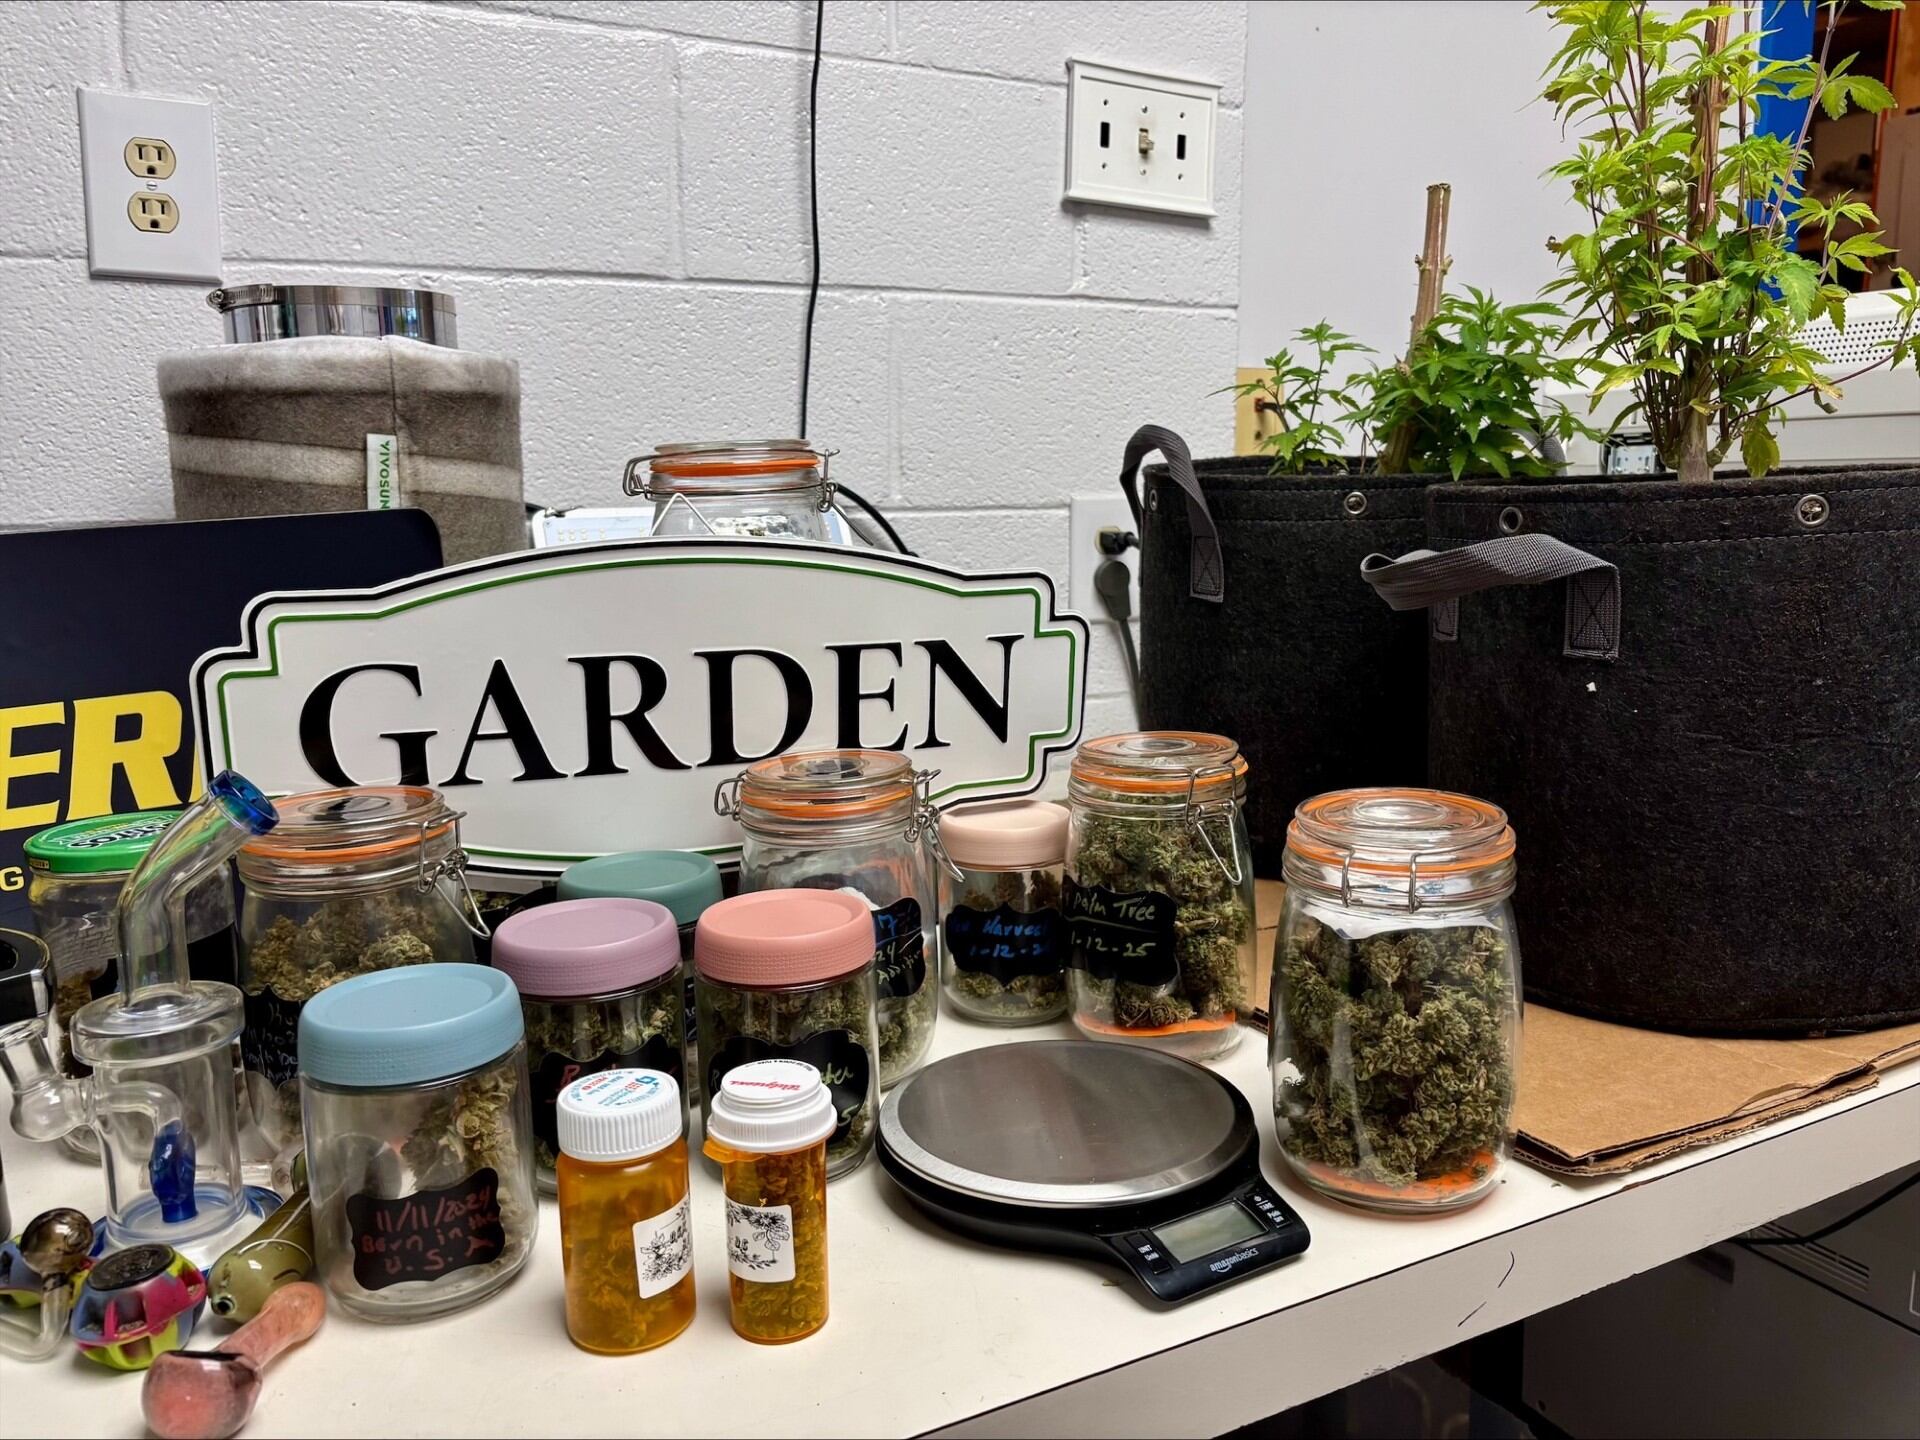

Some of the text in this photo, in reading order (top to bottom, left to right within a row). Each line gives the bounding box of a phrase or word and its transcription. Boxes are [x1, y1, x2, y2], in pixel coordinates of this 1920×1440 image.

[379, 440, 391, 510] VIVOSUN
[299, 633, 1025, 787] GARDEN
[0, 690, 205, 831] ER
[1112, 896, 1156, 922] Tree
[1209, 1246, 1260, 1272] amazonbasics
